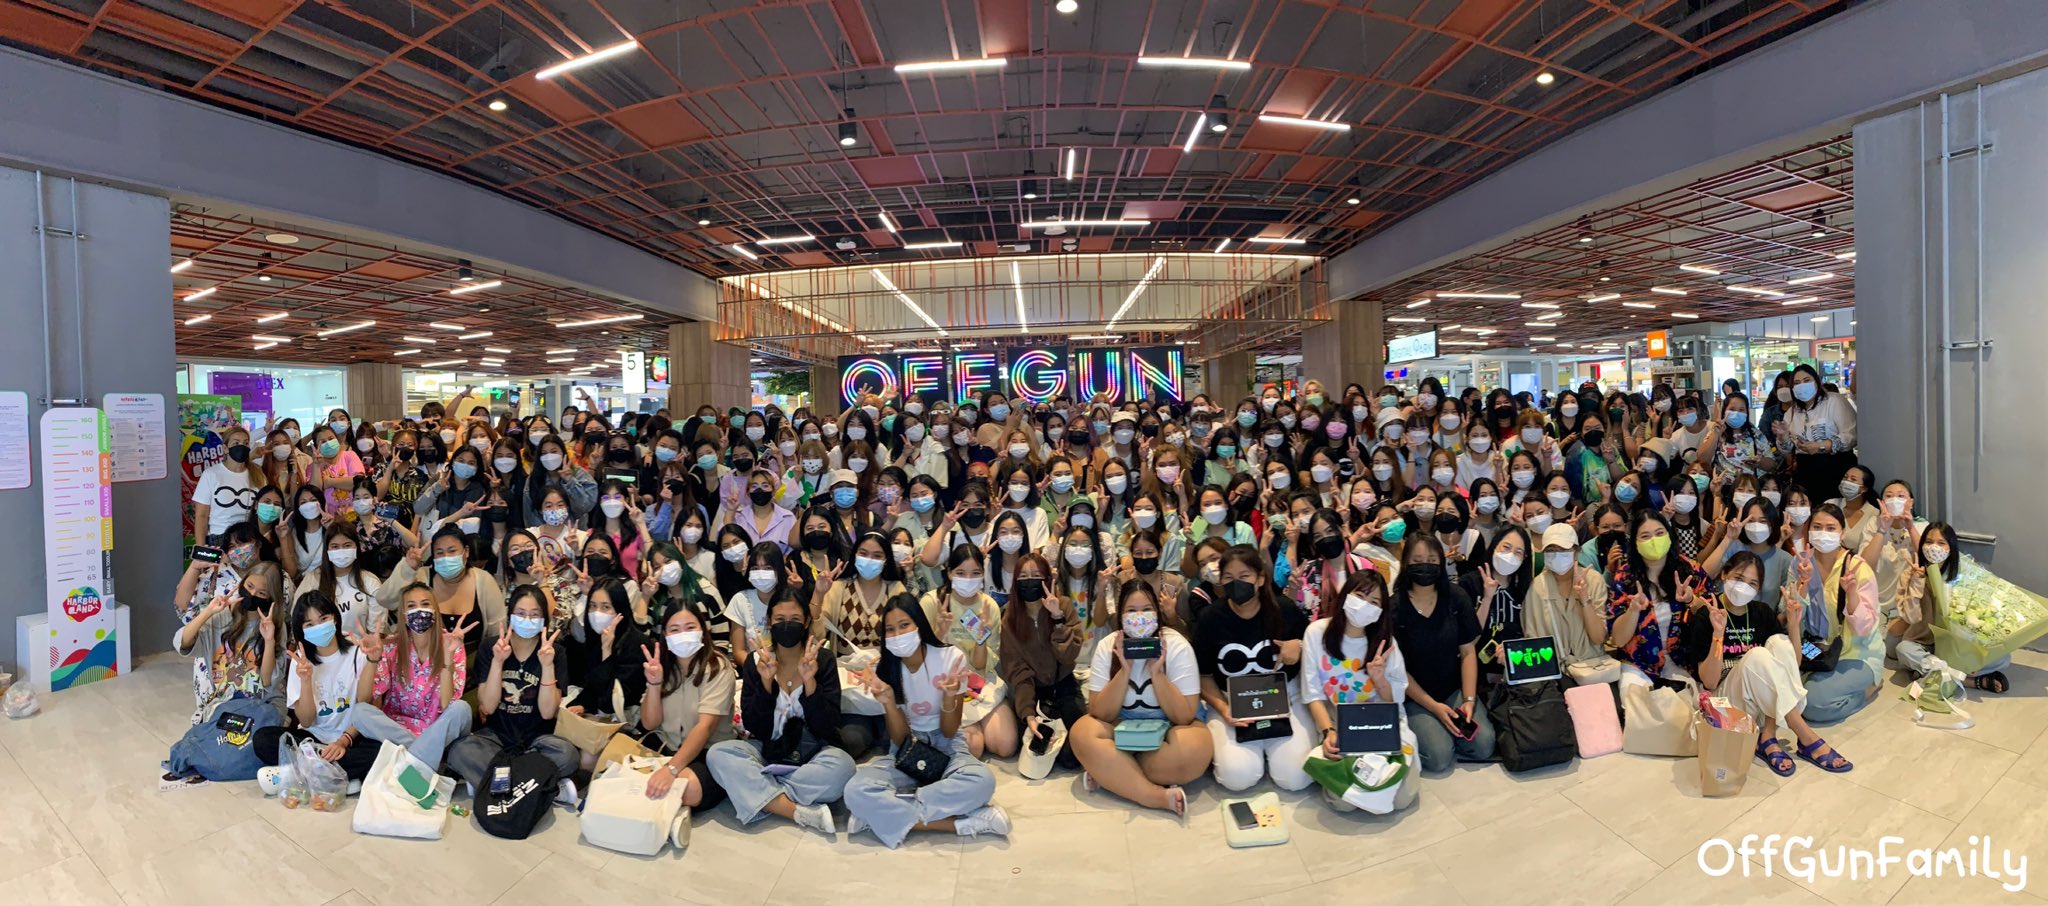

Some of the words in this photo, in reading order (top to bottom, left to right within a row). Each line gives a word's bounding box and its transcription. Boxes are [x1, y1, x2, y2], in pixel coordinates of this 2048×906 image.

[627, 353, 636, 370] 5
[841, 350, 1182, 405] OFFGUN
[187, 444, 224, 464] HARBO
[67, 596, 99, 606] HARBOR
